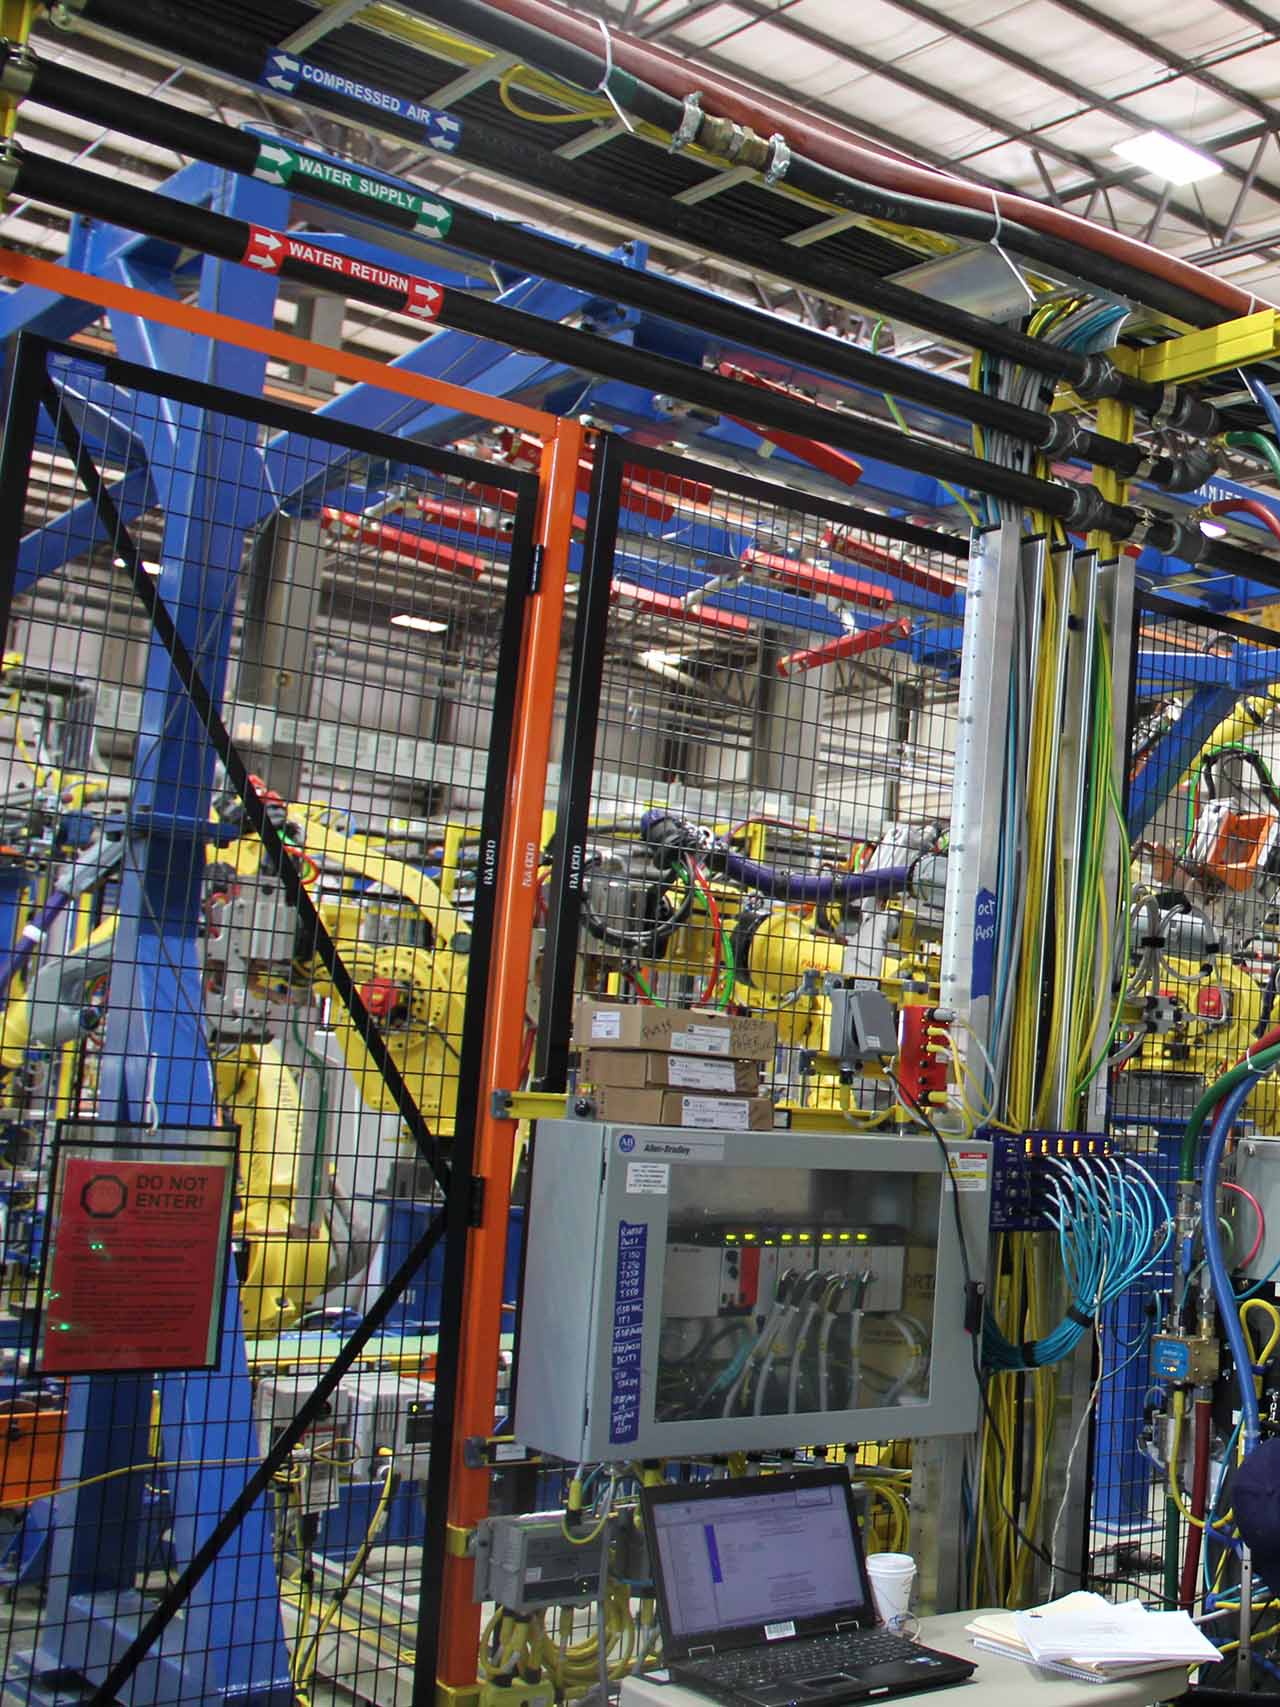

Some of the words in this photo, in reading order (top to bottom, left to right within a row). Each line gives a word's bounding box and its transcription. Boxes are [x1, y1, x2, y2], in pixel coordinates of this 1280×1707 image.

[302, 64, 401, 112] COMPRESSED
[406, 105, 431, 124] AIR
[299, 157, 352, 188] WATER
[359, 179, 416, 208] SUPPLY
[289, 242, 343, 272] WATER
[350, 259, 409, 292] RETURN
[644, 1144, 691, 1155] Allen-Bradley
[136, 1175, 163, 1190] DO
[168, 1176, 208, 1191] NOT
[135, 1193, 203, 1209] ENTER!
